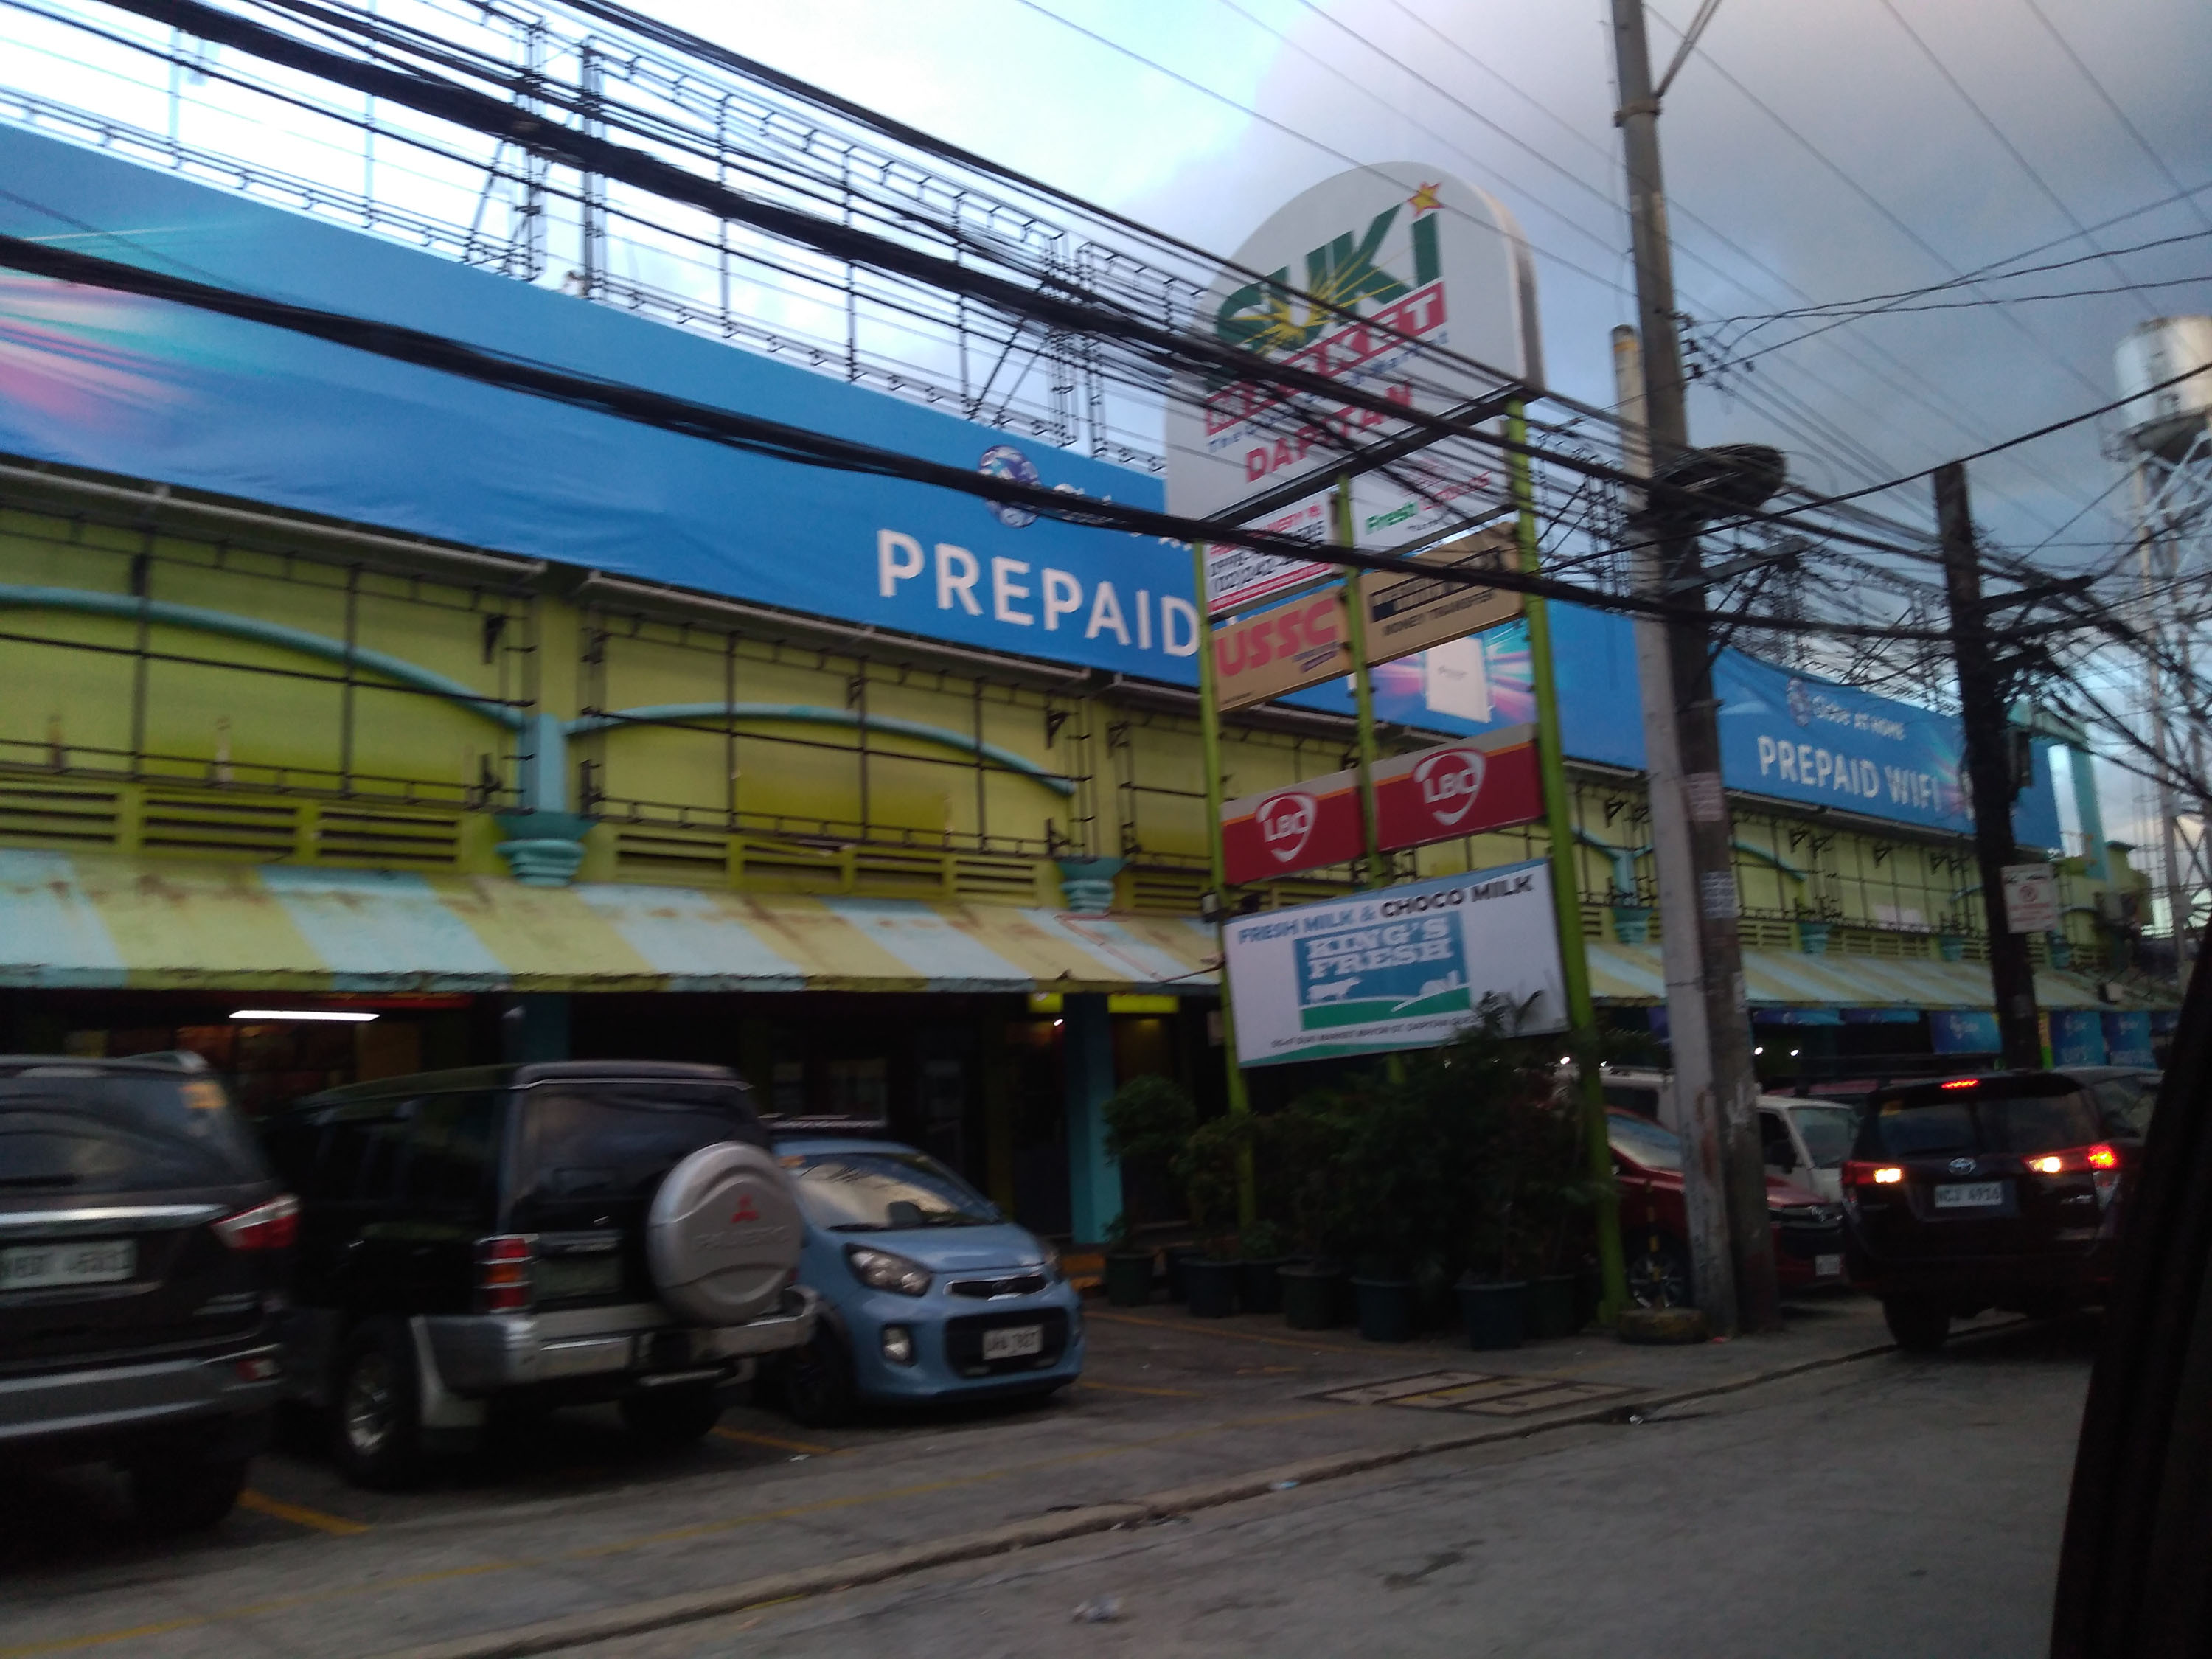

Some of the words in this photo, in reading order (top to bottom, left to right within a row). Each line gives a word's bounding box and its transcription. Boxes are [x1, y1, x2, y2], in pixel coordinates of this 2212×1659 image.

[1206, 203, 1441, 391] SUKI
[877, 528, 1201, 657] PREPAID
[1214, 597, 1340, 677] USSC
[1422, 768, 1478, 804] LBC
[1757, 734, 1880, 799] PREPAID
[1885, 764, 1942, 813] WIFI
[1262, 810, 1310, 843] LBC
[1239, 919, 1299, 945] FRESH
[1303, 908, 1354, 933] MILK
[1360, 905, 1377, 923] &
[1380, 888, 1465, 919] CHOCO
[1471, 874, 1536, 902] MILK
[1306, 916, 1451, 959] KING'S
[1307, 938, 1455, 980] FRESH
